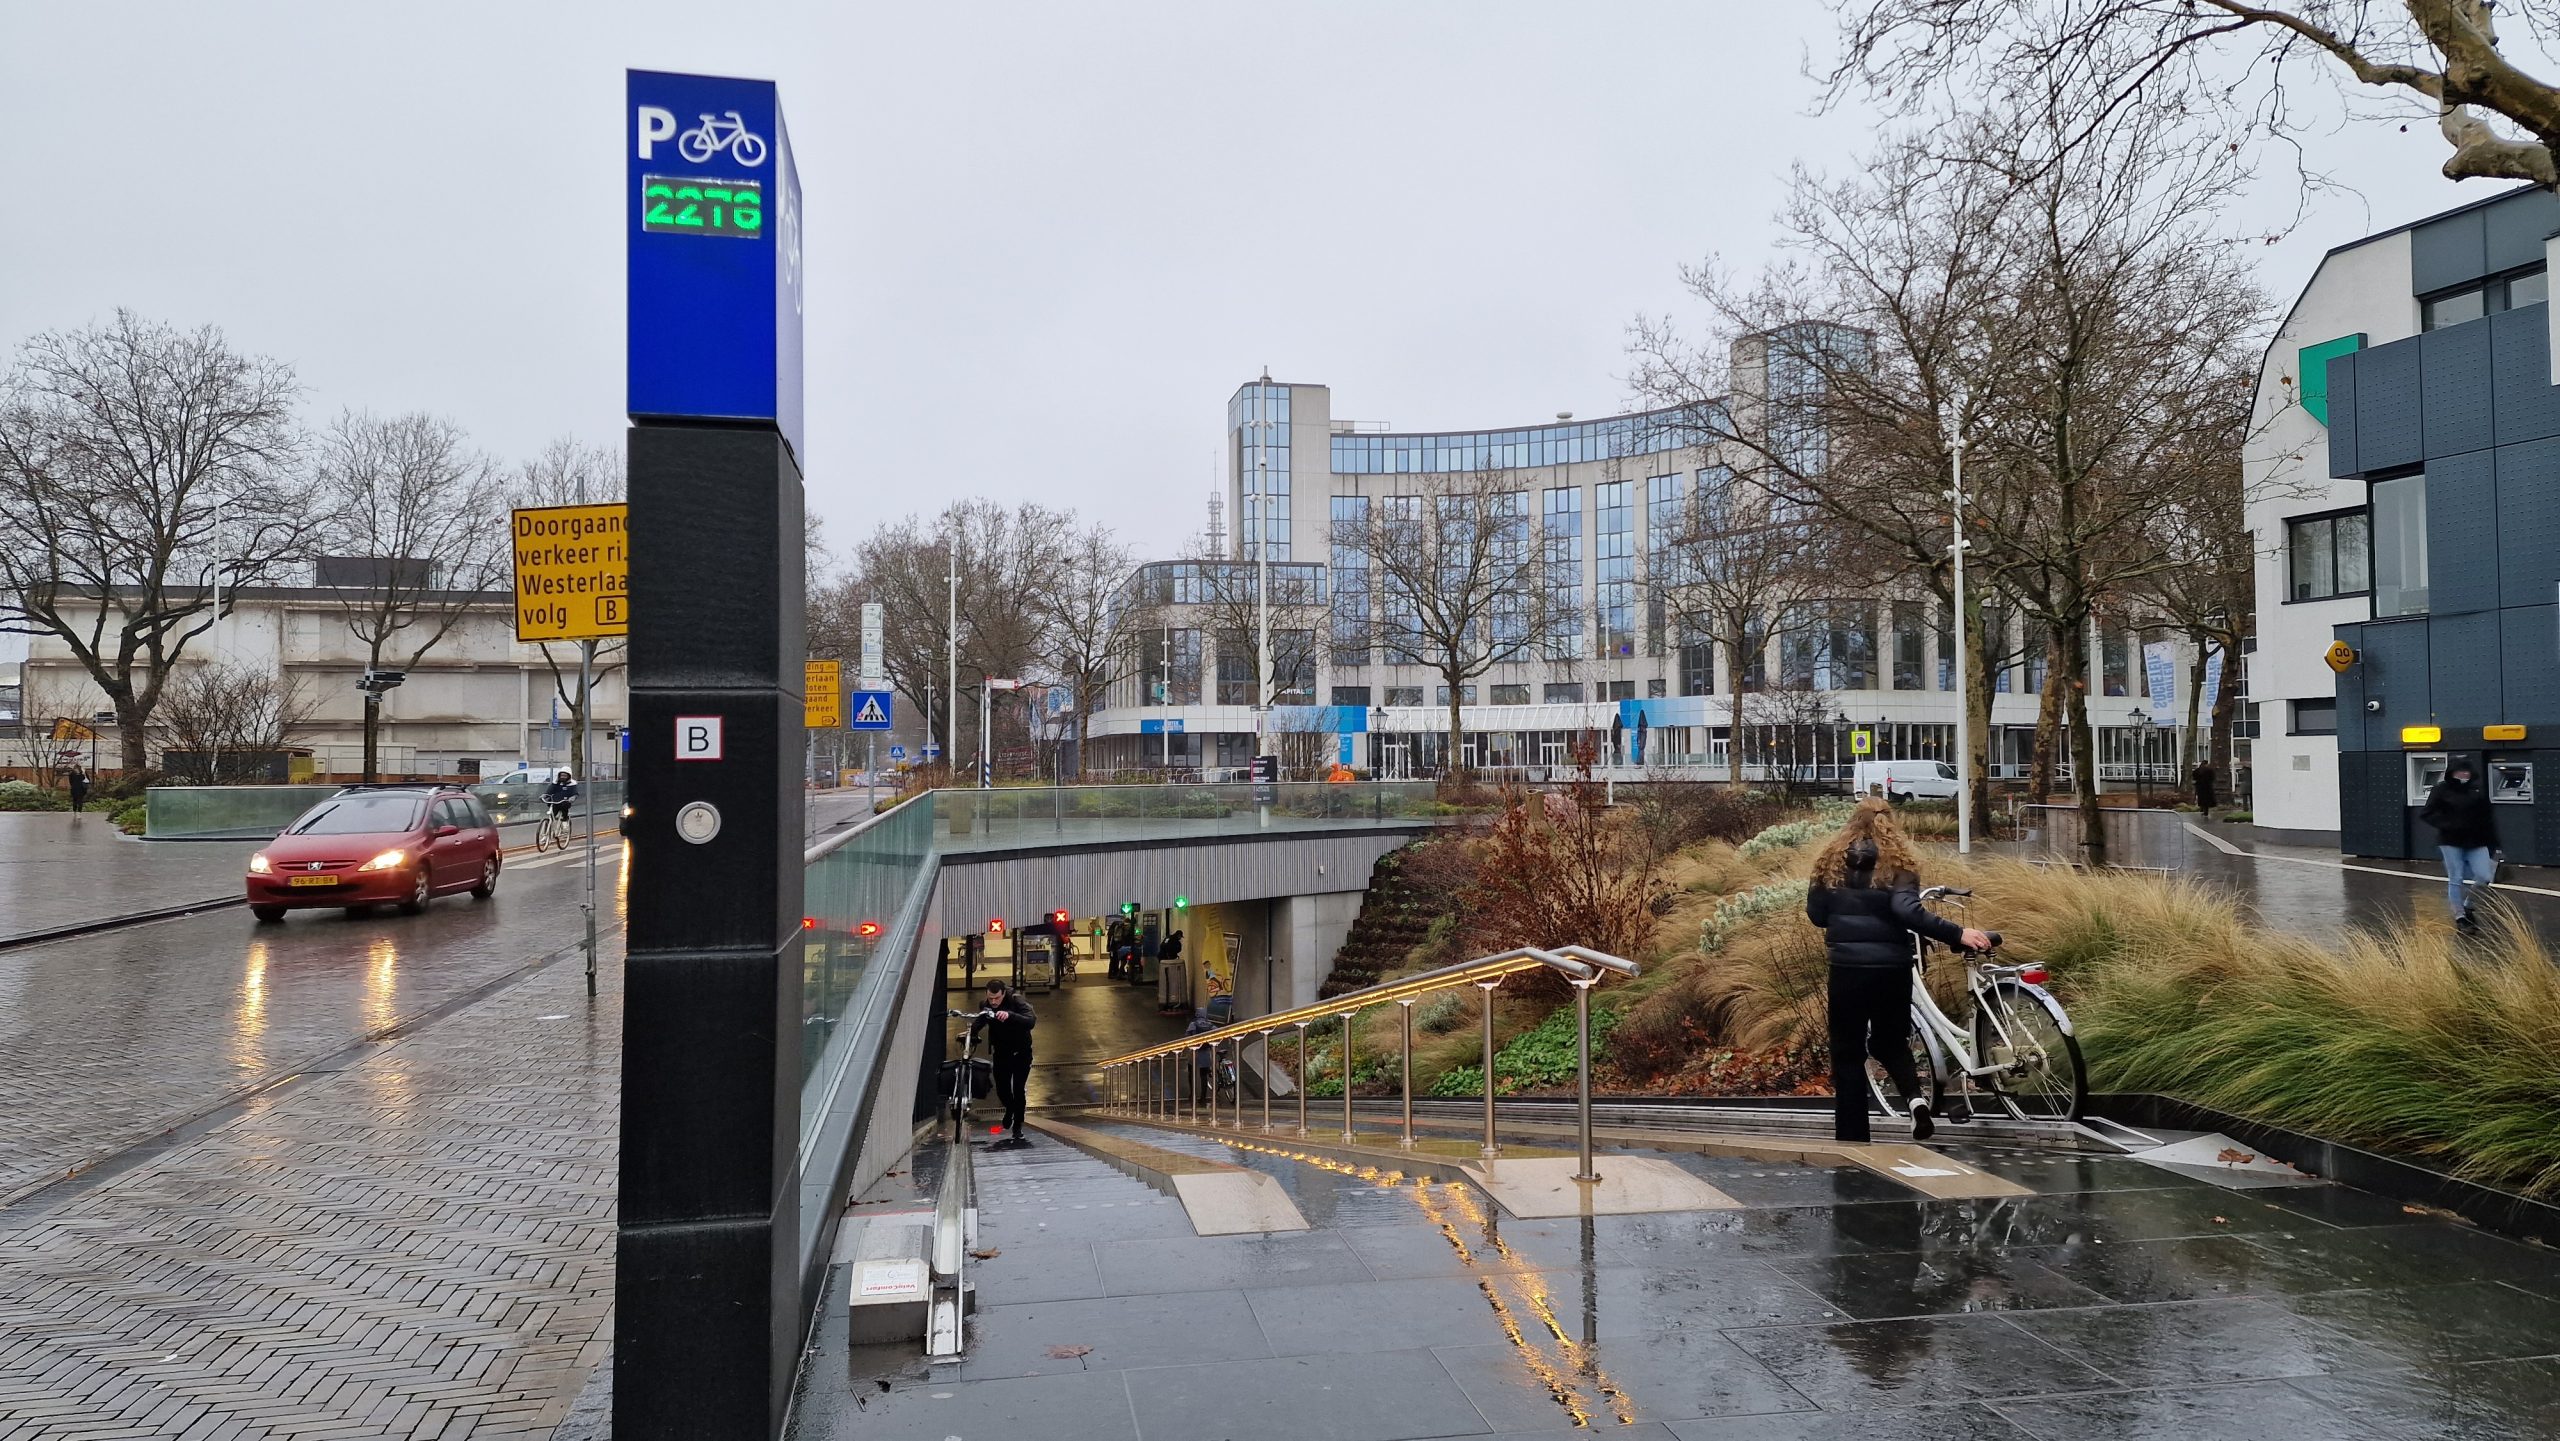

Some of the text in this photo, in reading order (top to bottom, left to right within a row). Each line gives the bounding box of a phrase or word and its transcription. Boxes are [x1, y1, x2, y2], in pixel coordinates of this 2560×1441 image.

[637, 105, 677, 160] P
[518, 544, 599, 566] verkeer
[523, 599, 617, 630] volg B
[688, 726, 710, 752] B
